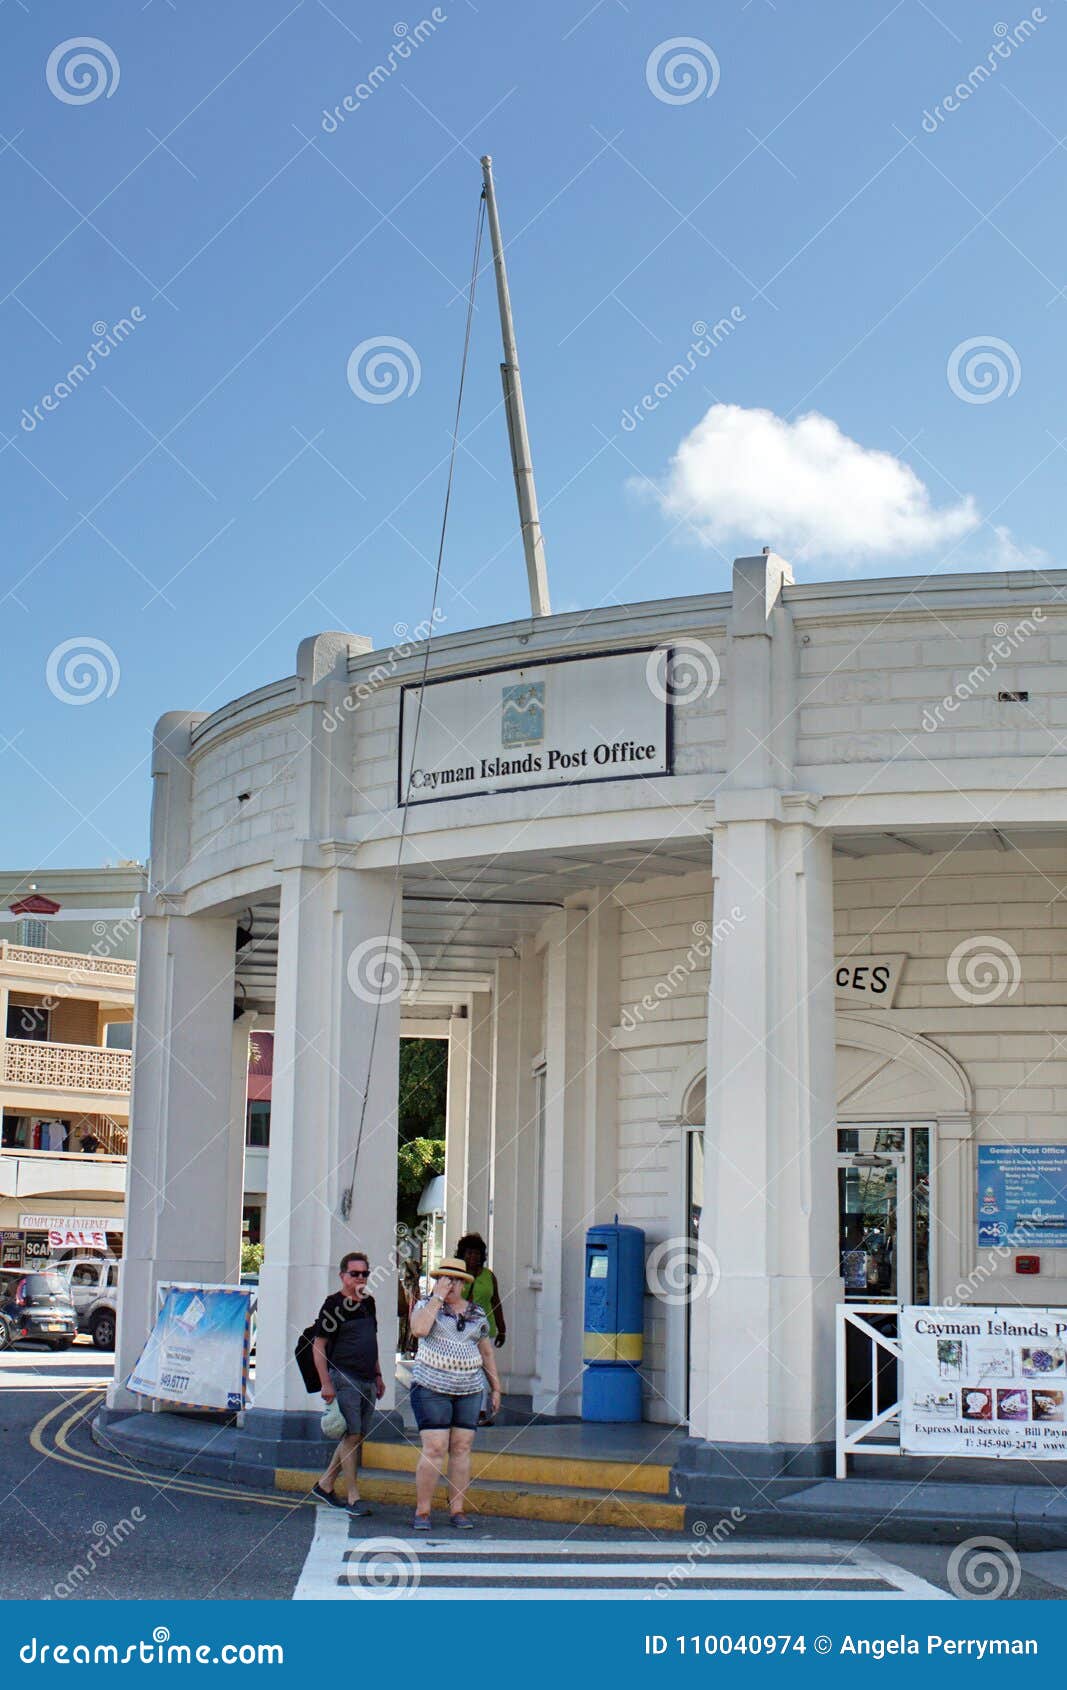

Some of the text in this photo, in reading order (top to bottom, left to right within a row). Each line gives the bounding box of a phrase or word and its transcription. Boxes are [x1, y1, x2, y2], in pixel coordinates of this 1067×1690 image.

[410, 741, 656, 789] Cayman Islands Post Office
[835, 966, 890, 994] CES
[49, 1230, 105, 1247] SALE
[914, 1318, 981, 1337] Cayman
[986, 1320, 1049, 1336] Islands
[914, 1423, 951, 1436] Express
[953, 1424, 974, 1435] Mail
[977, 1426, 1010, 1436] Service
[1024, 1427, 1041, 1436] Bill
[976, 1439, 1037, 1449] 345-949-2474
